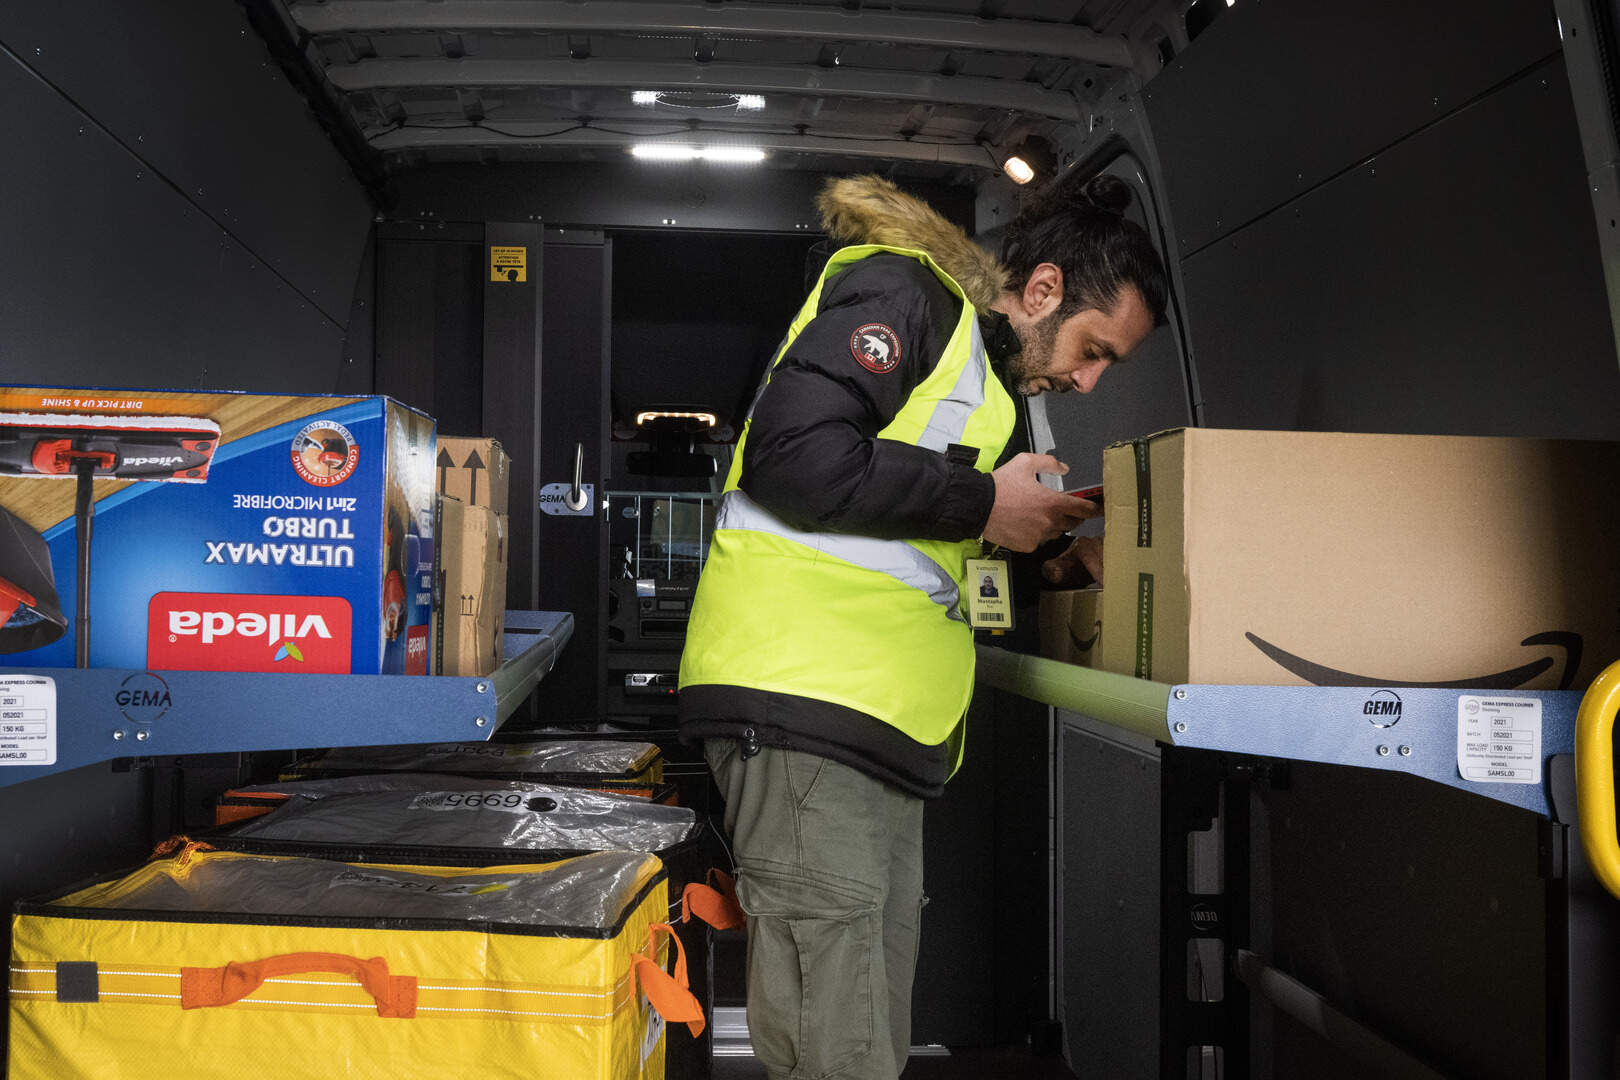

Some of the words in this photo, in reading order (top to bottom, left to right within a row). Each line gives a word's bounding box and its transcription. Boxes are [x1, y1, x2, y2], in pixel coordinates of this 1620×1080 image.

[41, 398, 71, 407] SHINE
[82, 399, 95, 408] UP
[97, 400, 118, 408] PICK
[120, 400, 143, 409] DIRT
[123, 456, 184, 466] vileda
[331, 449, 357, 483] COMFORT
[293, 455, 327, 484] CLEANING
[233, 494, 322, 510] MICROFIBRE
[326, 497, 356, 511] 2in1
[539, 495, 566, 503] GEMA
[263, 516, 354, 539] TURBO
[205, 542, 354, 567] ULTRAMAX
[408, 636, 426, 658] vileda
[115, 690, 172, 707] GEMA
[1363, 700, 1402, 715] GEMA
[444, 794, 521, 807] 6995
